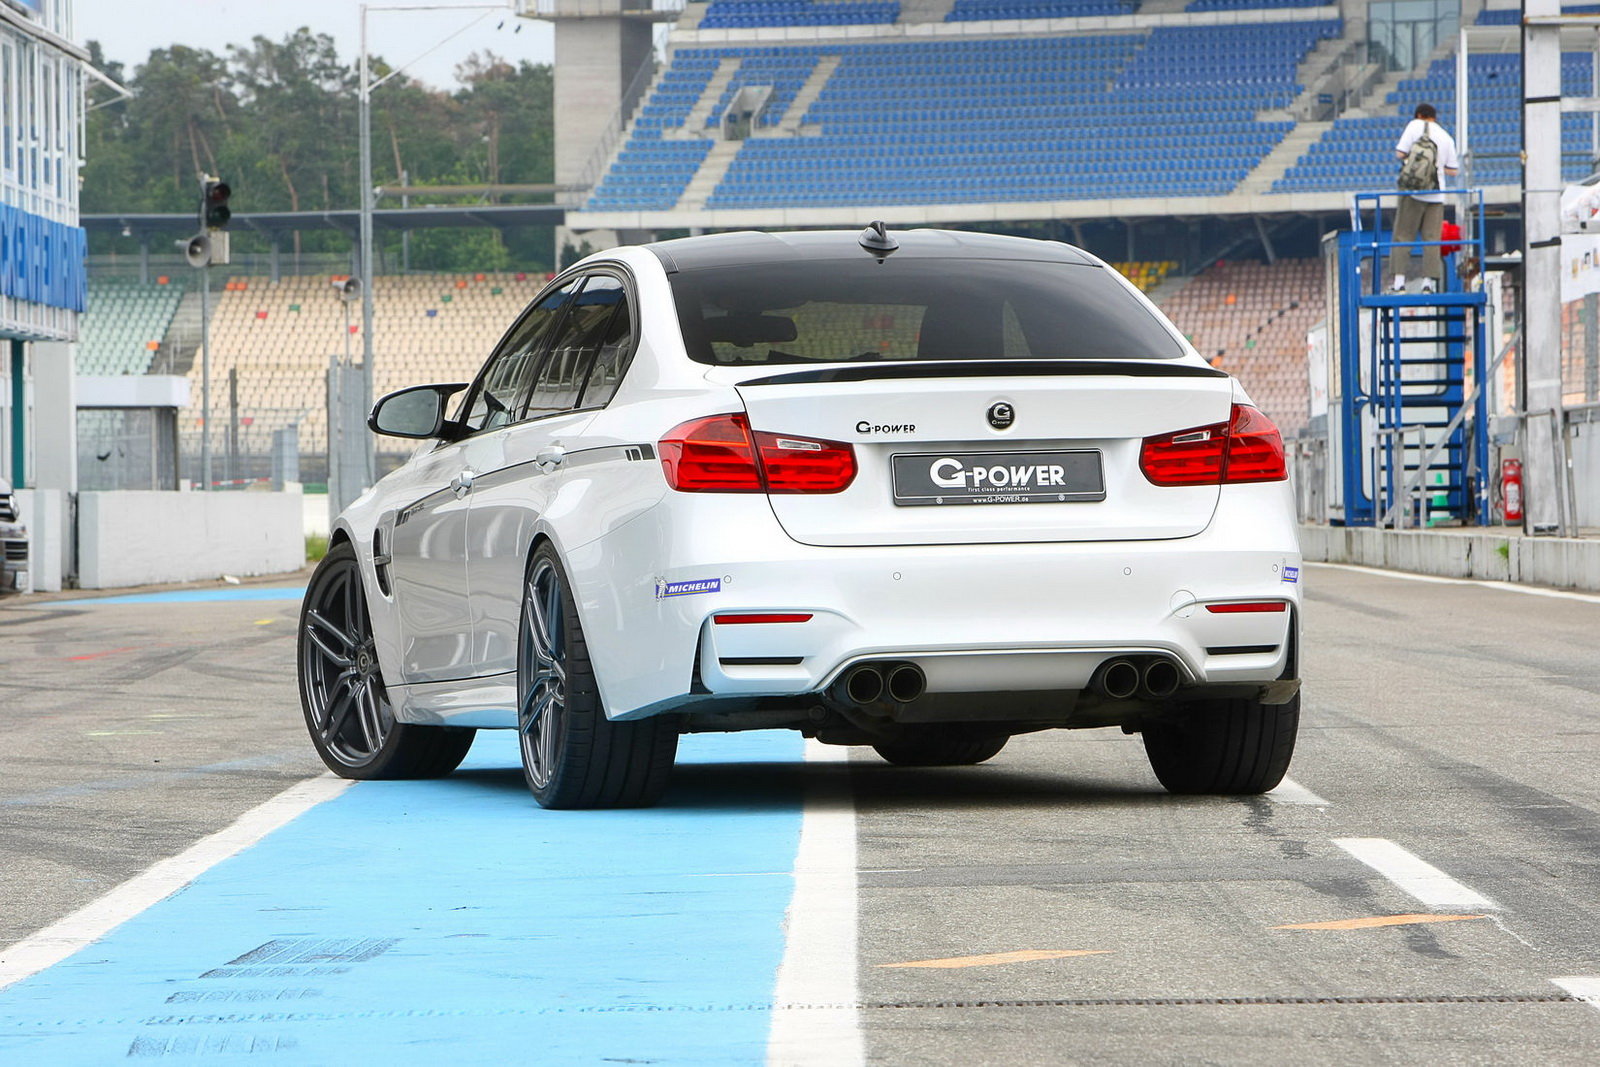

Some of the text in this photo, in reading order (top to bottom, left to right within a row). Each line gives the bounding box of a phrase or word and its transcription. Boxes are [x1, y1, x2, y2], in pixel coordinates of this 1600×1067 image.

[855, 421, 916, 434] G-POWER
[929, 458, 1066, 488] G-POWER
[668, 581, 719, 593] MICHELIN
